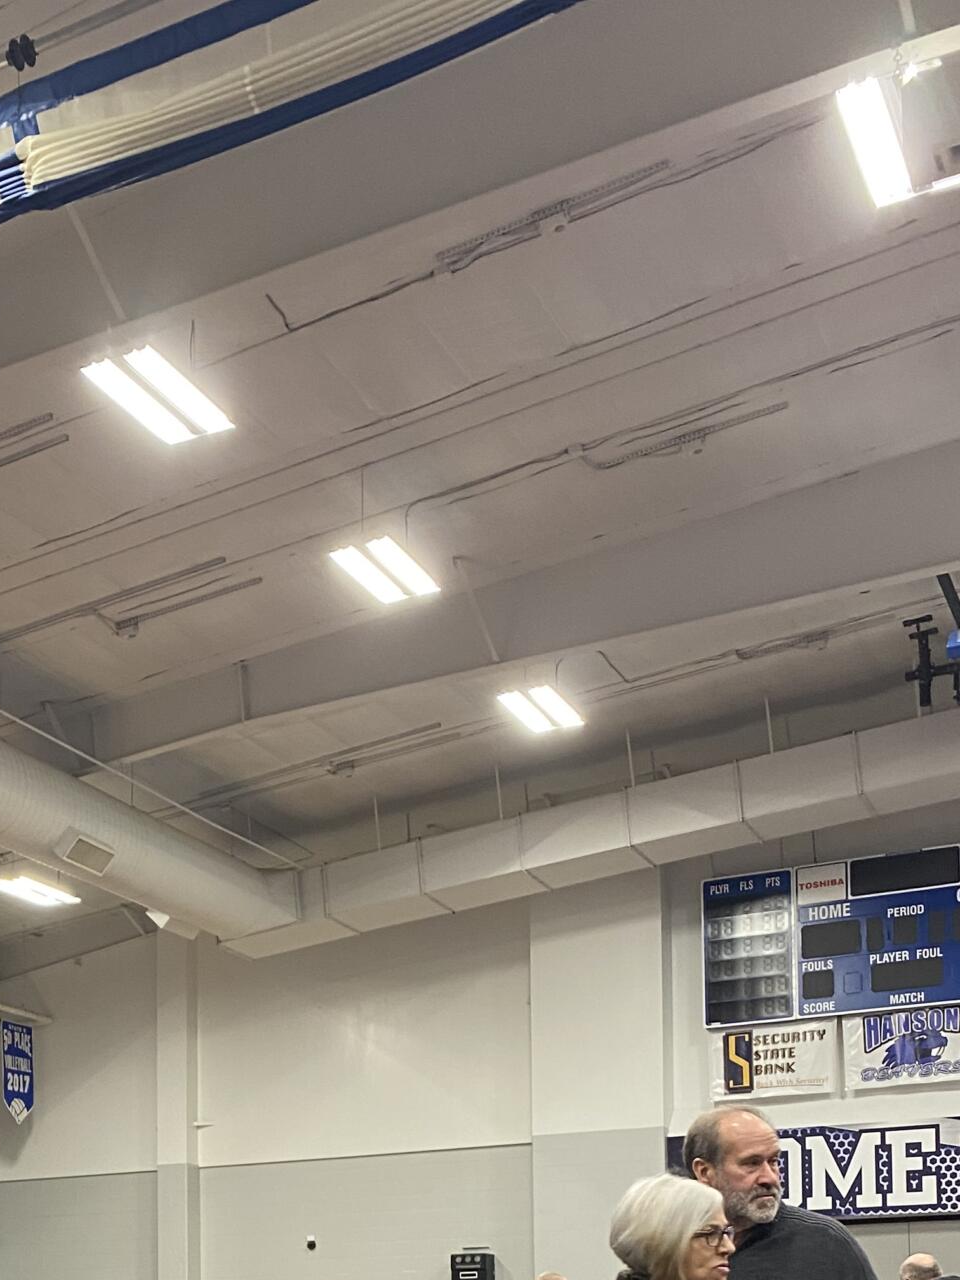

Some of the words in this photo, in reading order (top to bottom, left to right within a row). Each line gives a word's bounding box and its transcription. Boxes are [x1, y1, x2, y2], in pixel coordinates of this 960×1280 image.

[710, 884, 729, 895] PLYR
[740, 880, 754, 891] FLS
[766, 877, 780, 887] PTS
[799, 878, 844, 890] TOSHIBA
[808, 903, 851, 920] HOME
[888, 904, 924, 918] PERIOD
[870, 951, 909, 965] PLAYER
[916, 947, 943, 959] FOUL
[802, 960, 833, 972] FOULS
[890, 992, 924, 1004] MATCH
[804, 1001, 835, 1013] SCORE
[864, 1007, 960, 1053] HANSON
[753, 1029, 826, 1046] SECURITY
[754, 1047, 796, 1060] STATE
[754, 1062, 795, 1076] BANK
[8, 1072, 30, 1093] 2017
